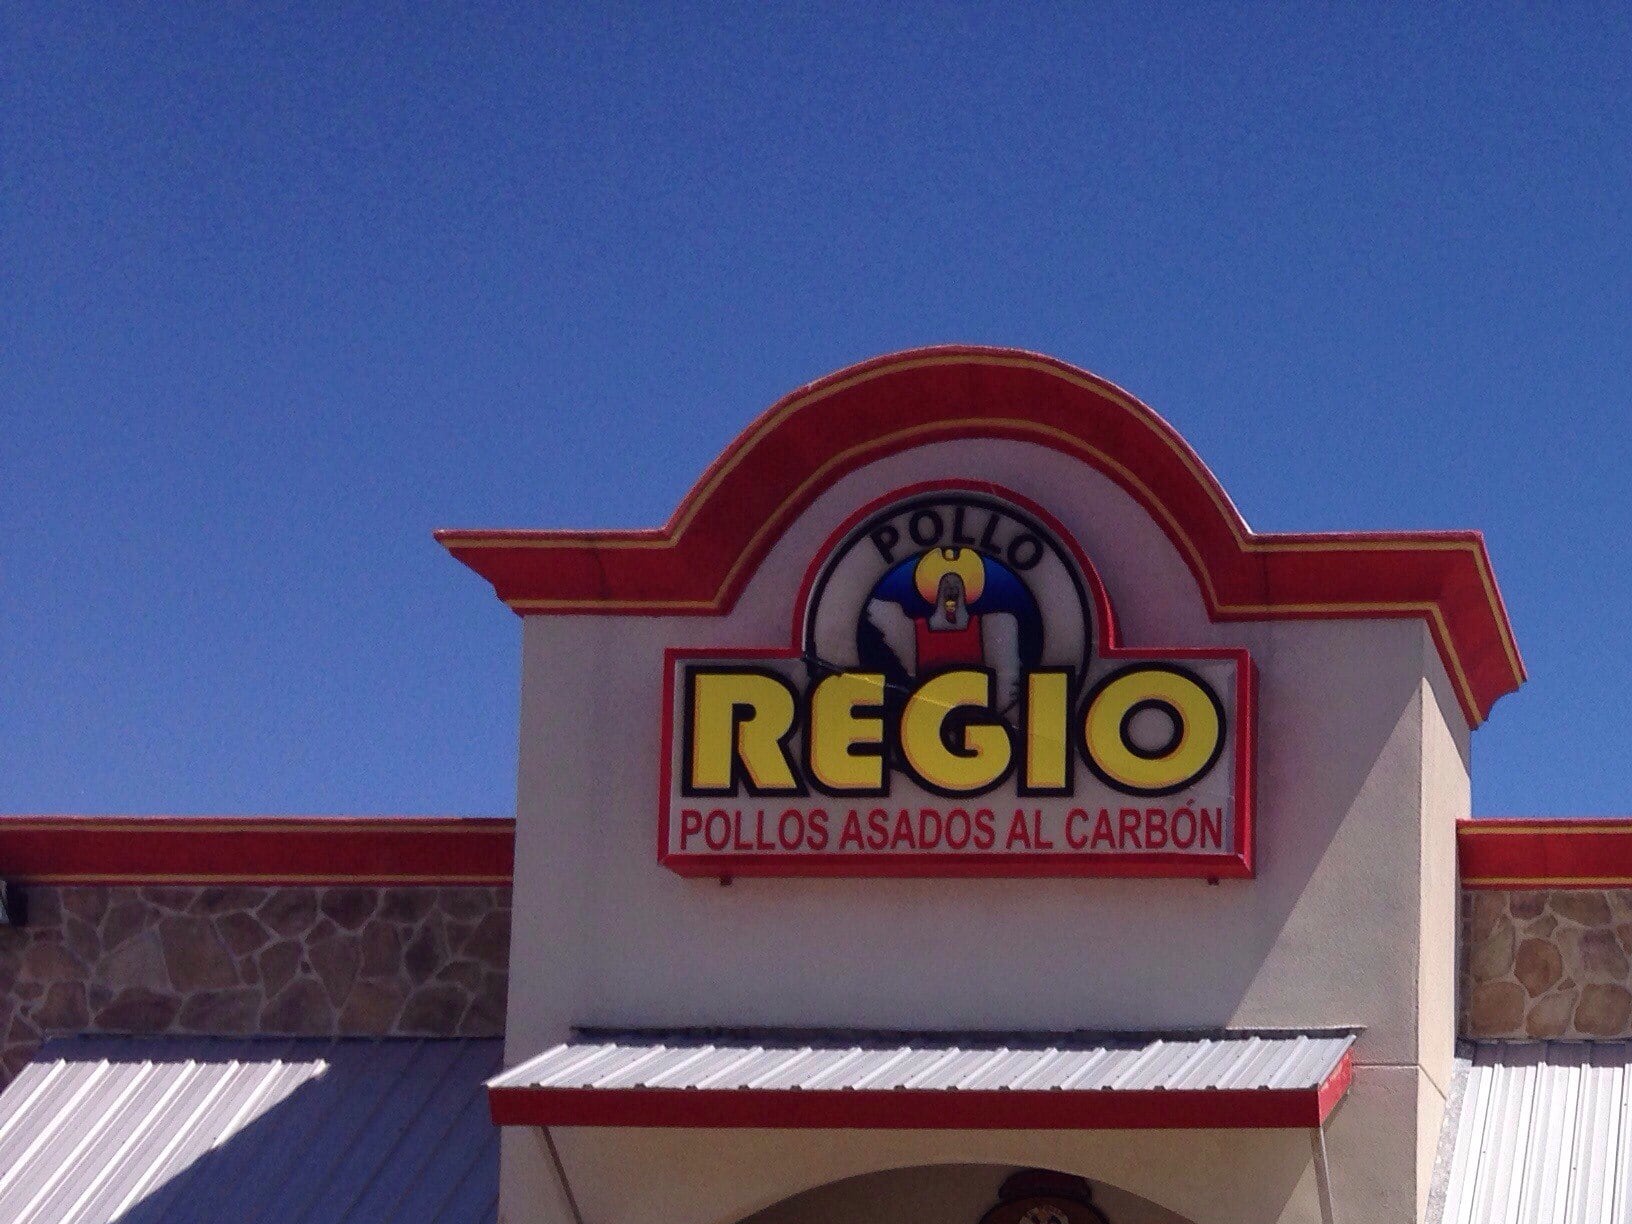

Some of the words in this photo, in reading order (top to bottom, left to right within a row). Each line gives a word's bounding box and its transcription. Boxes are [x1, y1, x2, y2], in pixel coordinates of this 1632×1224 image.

[867, 506, 1045, 571] POLLO
[682, 663, 1226, 797] REGIO
[680, 808, 829, 851] POLLOS
[839, 808, 996, 851] ASADOS
[1006, 809, 1056, 850] AL
[1065, 799, 1223, 851] CARBÓN
